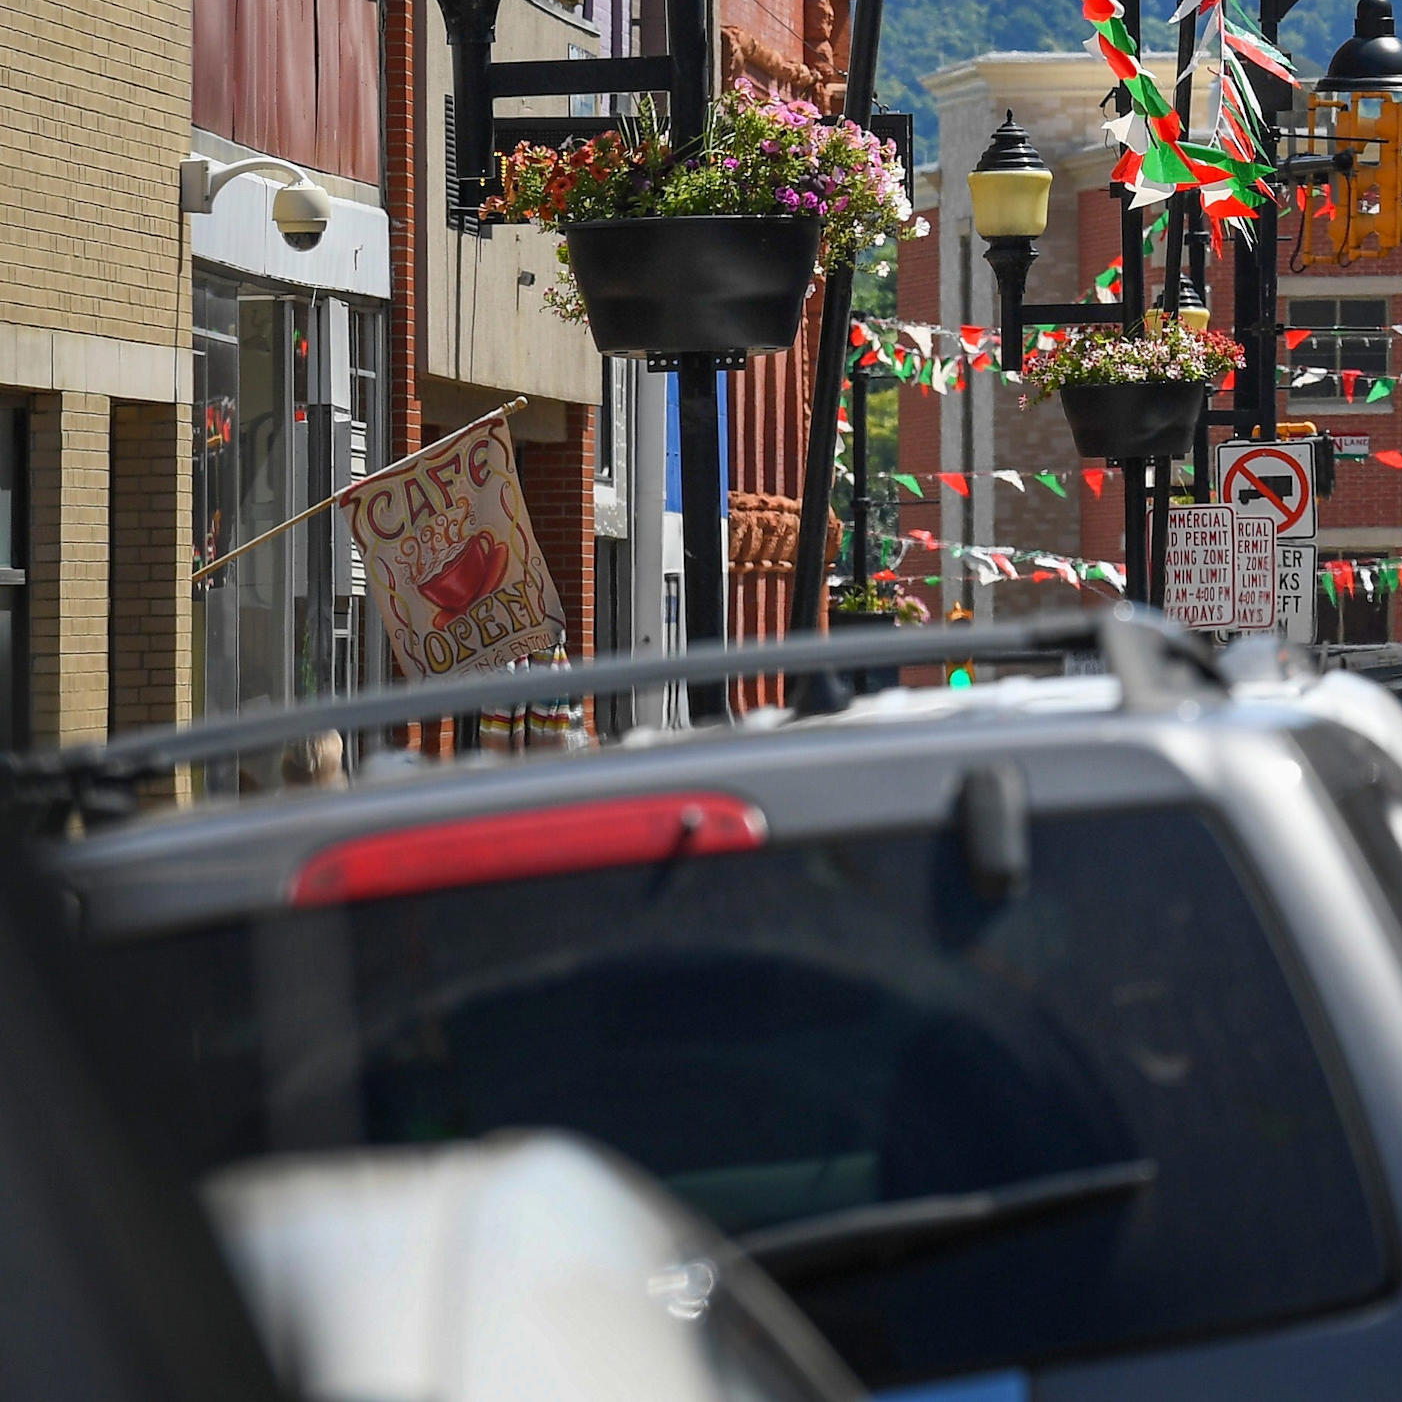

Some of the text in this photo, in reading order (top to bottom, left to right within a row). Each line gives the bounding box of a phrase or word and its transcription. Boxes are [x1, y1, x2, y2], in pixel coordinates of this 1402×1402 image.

[366, 439, 491, 540] CAFE
[1169, 512, 1228, 528] MMERCIAL
[1238, 522, 1269, 537] RCIAL
[1185, 530, 1228, 547] PERMIT
[1237, 540, 1269, 554] ERMIT
[1165, 549, 1197, 566] ADING
[1203, 549, 1230, 565] ZONE
[1246, 556, 1270, 571] ZONE
[1174, 569, 1192, 584] MIN
[1200, 568, 1227, 584] LIMIT
[1242, 574, 1267, 588] LIMIT
[424, 579, 543, 675] OPEN
